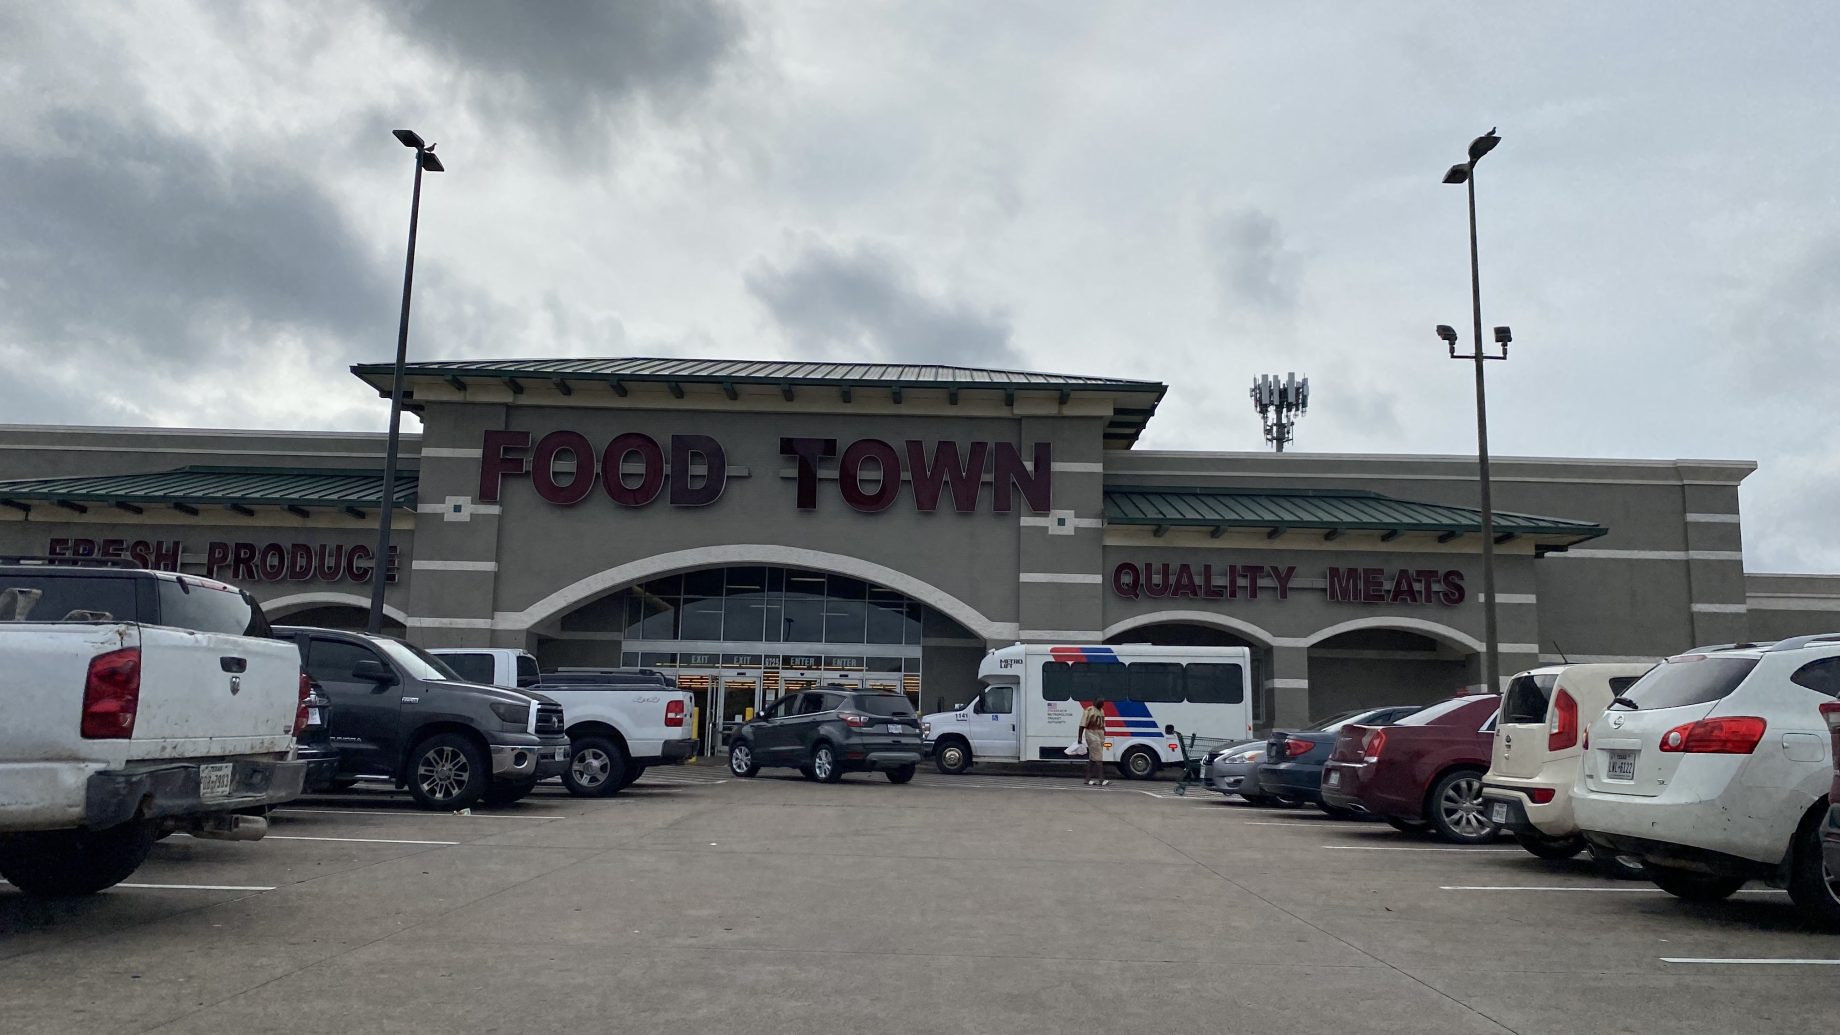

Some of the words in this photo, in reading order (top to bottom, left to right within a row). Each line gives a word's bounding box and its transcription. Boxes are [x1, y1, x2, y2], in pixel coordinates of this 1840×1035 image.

[478, 429, 728, 508] FOOD
[779, 437, 1054, 514] TOWN
[1112, 561, 1297, 601] QUALITY
[1326, 566, 1466, 605] MEATS
[691, 655, 709, 664] EXIT
[733, 656, 752, 665] EXIT
[790, 657, 815, 666] ENTER
[832, 658, 857, 667] ENTER
